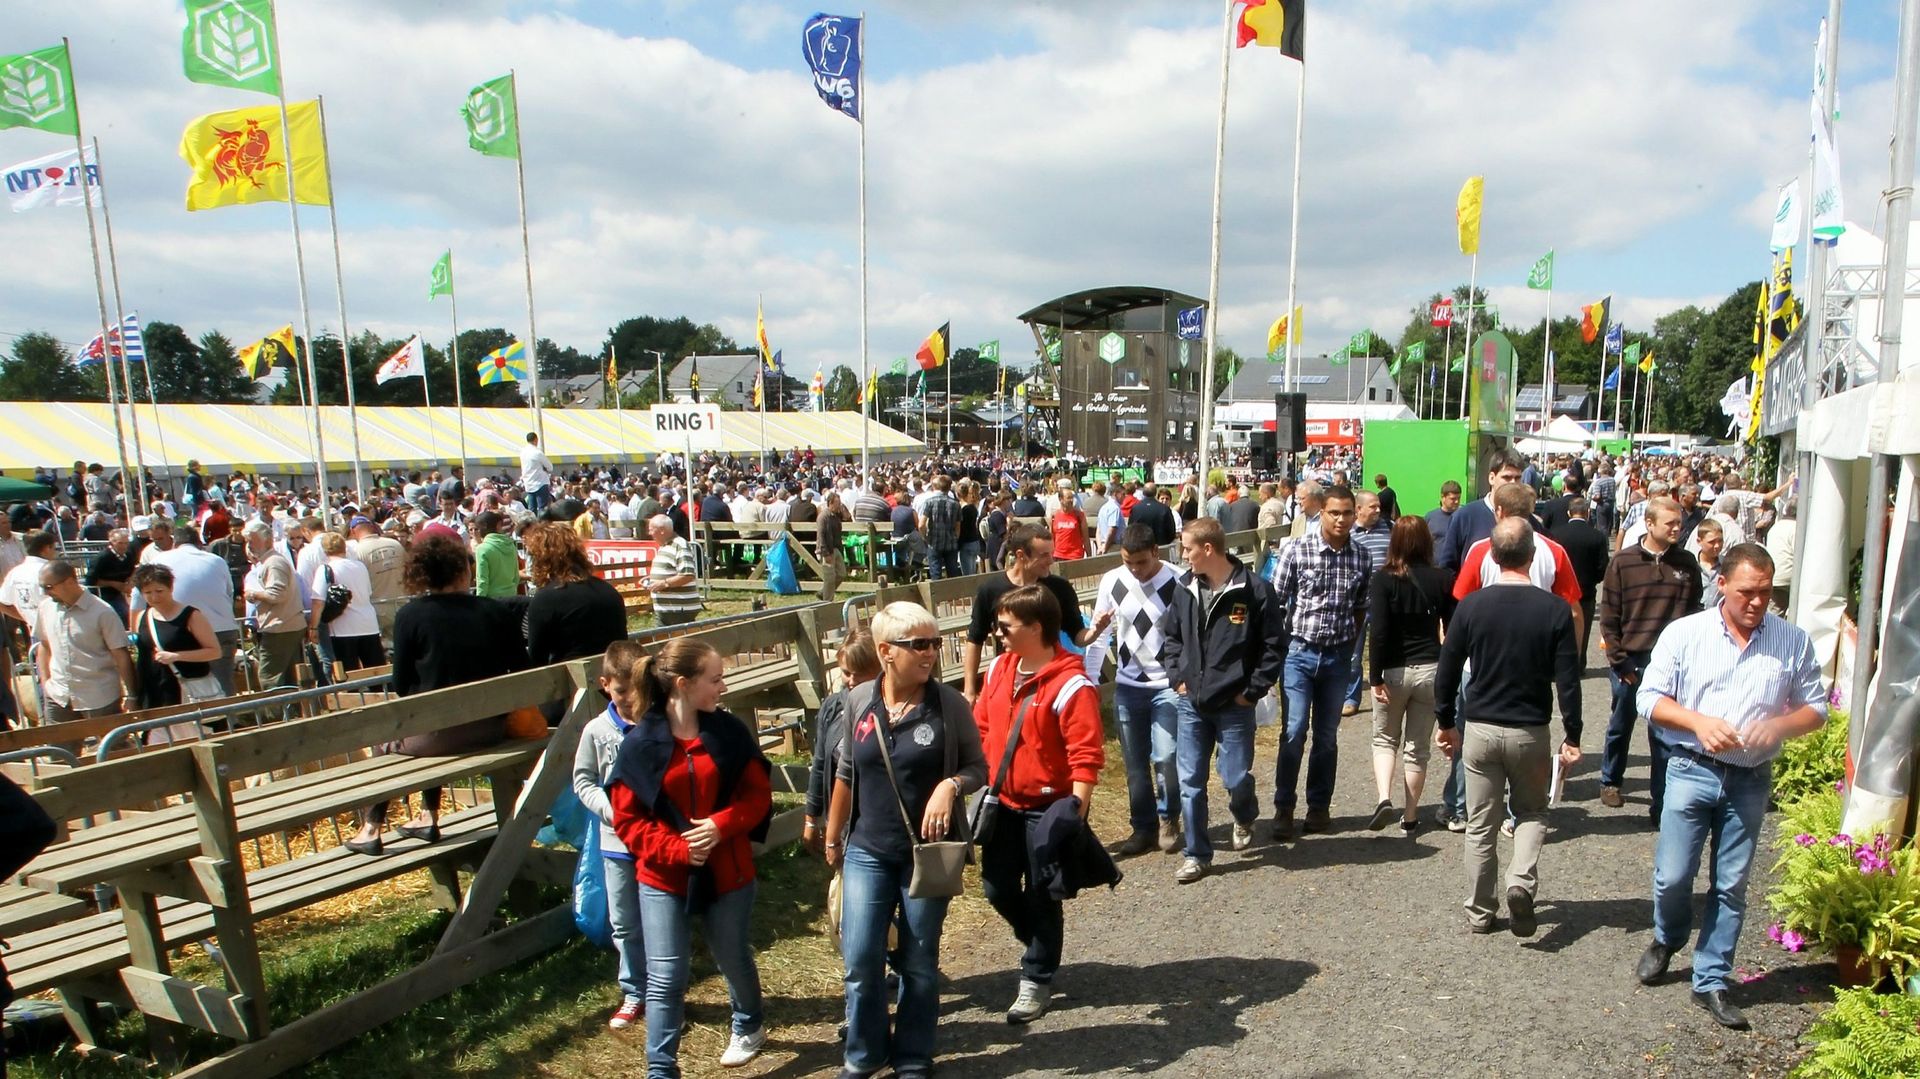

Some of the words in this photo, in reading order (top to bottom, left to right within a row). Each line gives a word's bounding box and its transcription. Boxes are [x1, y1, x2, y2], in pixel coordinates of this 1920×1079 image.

[1107, 392, 1129, 402] Tour
[1072, 402, 1083, 412] du
[1085, 402, 1110, 413] Crédit
[1111, 404, 1148, 416] Agricole
[656, 412, 702, 431] RING
[706, 412, 714, 430] 1
